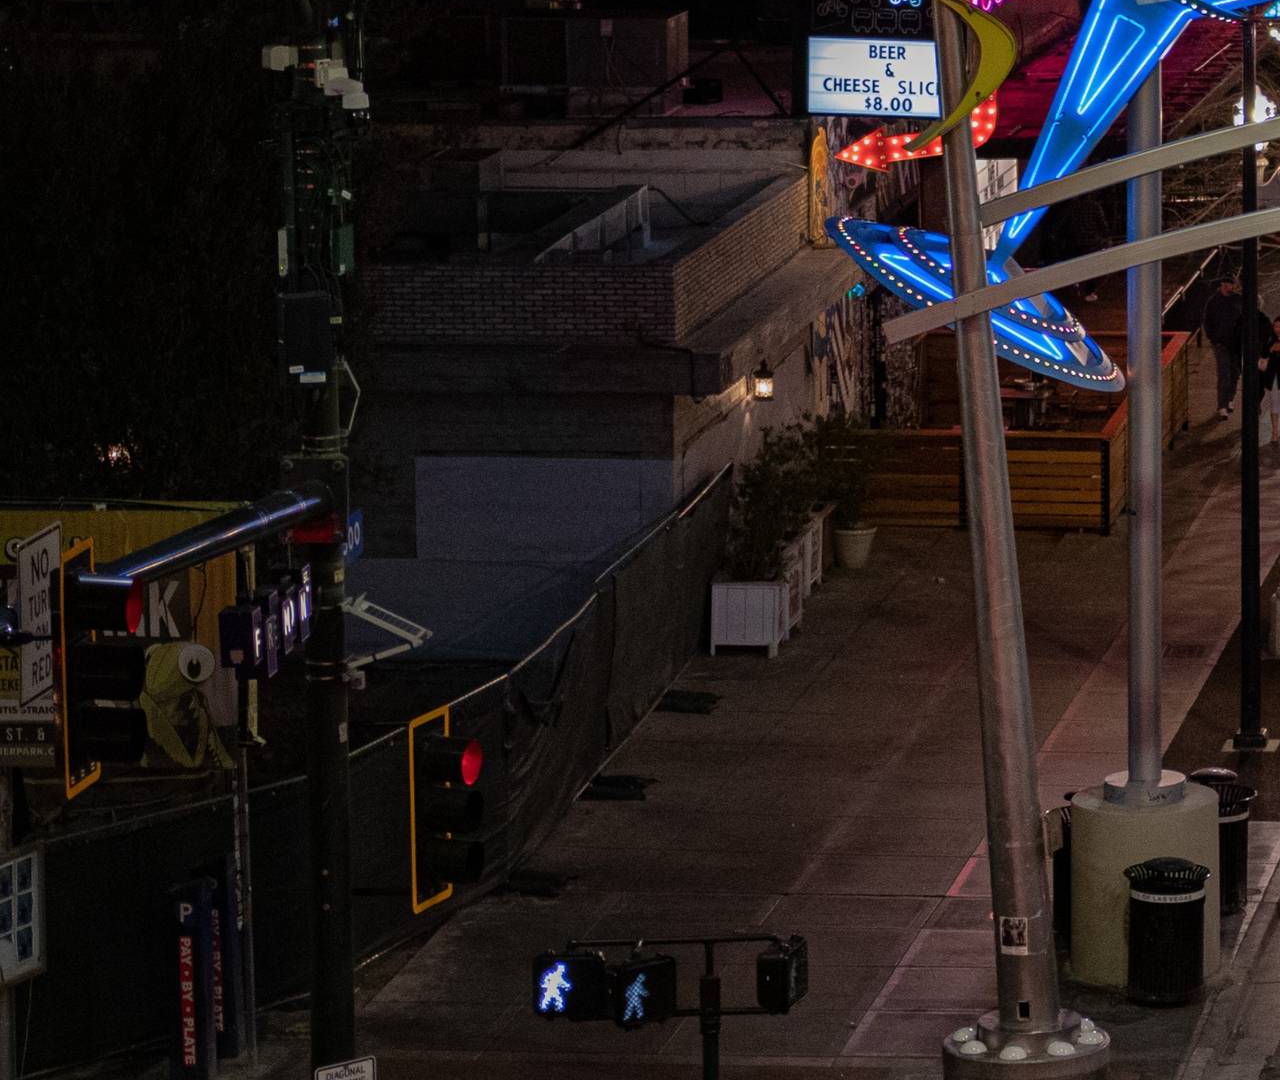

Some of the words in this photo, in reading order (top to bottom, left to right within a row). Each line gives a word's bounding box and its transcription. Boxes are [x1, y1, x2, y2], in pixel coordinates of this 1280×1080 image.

[869, 45, 906, 60] BEER
[885, 63, 895, 77] &
[823, 77, 880, 93] CHEESE
[864, 97, 912, 112] $8.00
[31, 547, 49, 587] NO
[31, 654, 50, 687] RED
[180, 936, 193, 966] PAY
[181, 981, 194, 1001] BY
[183, 1017, 197, 1065] PLATE
